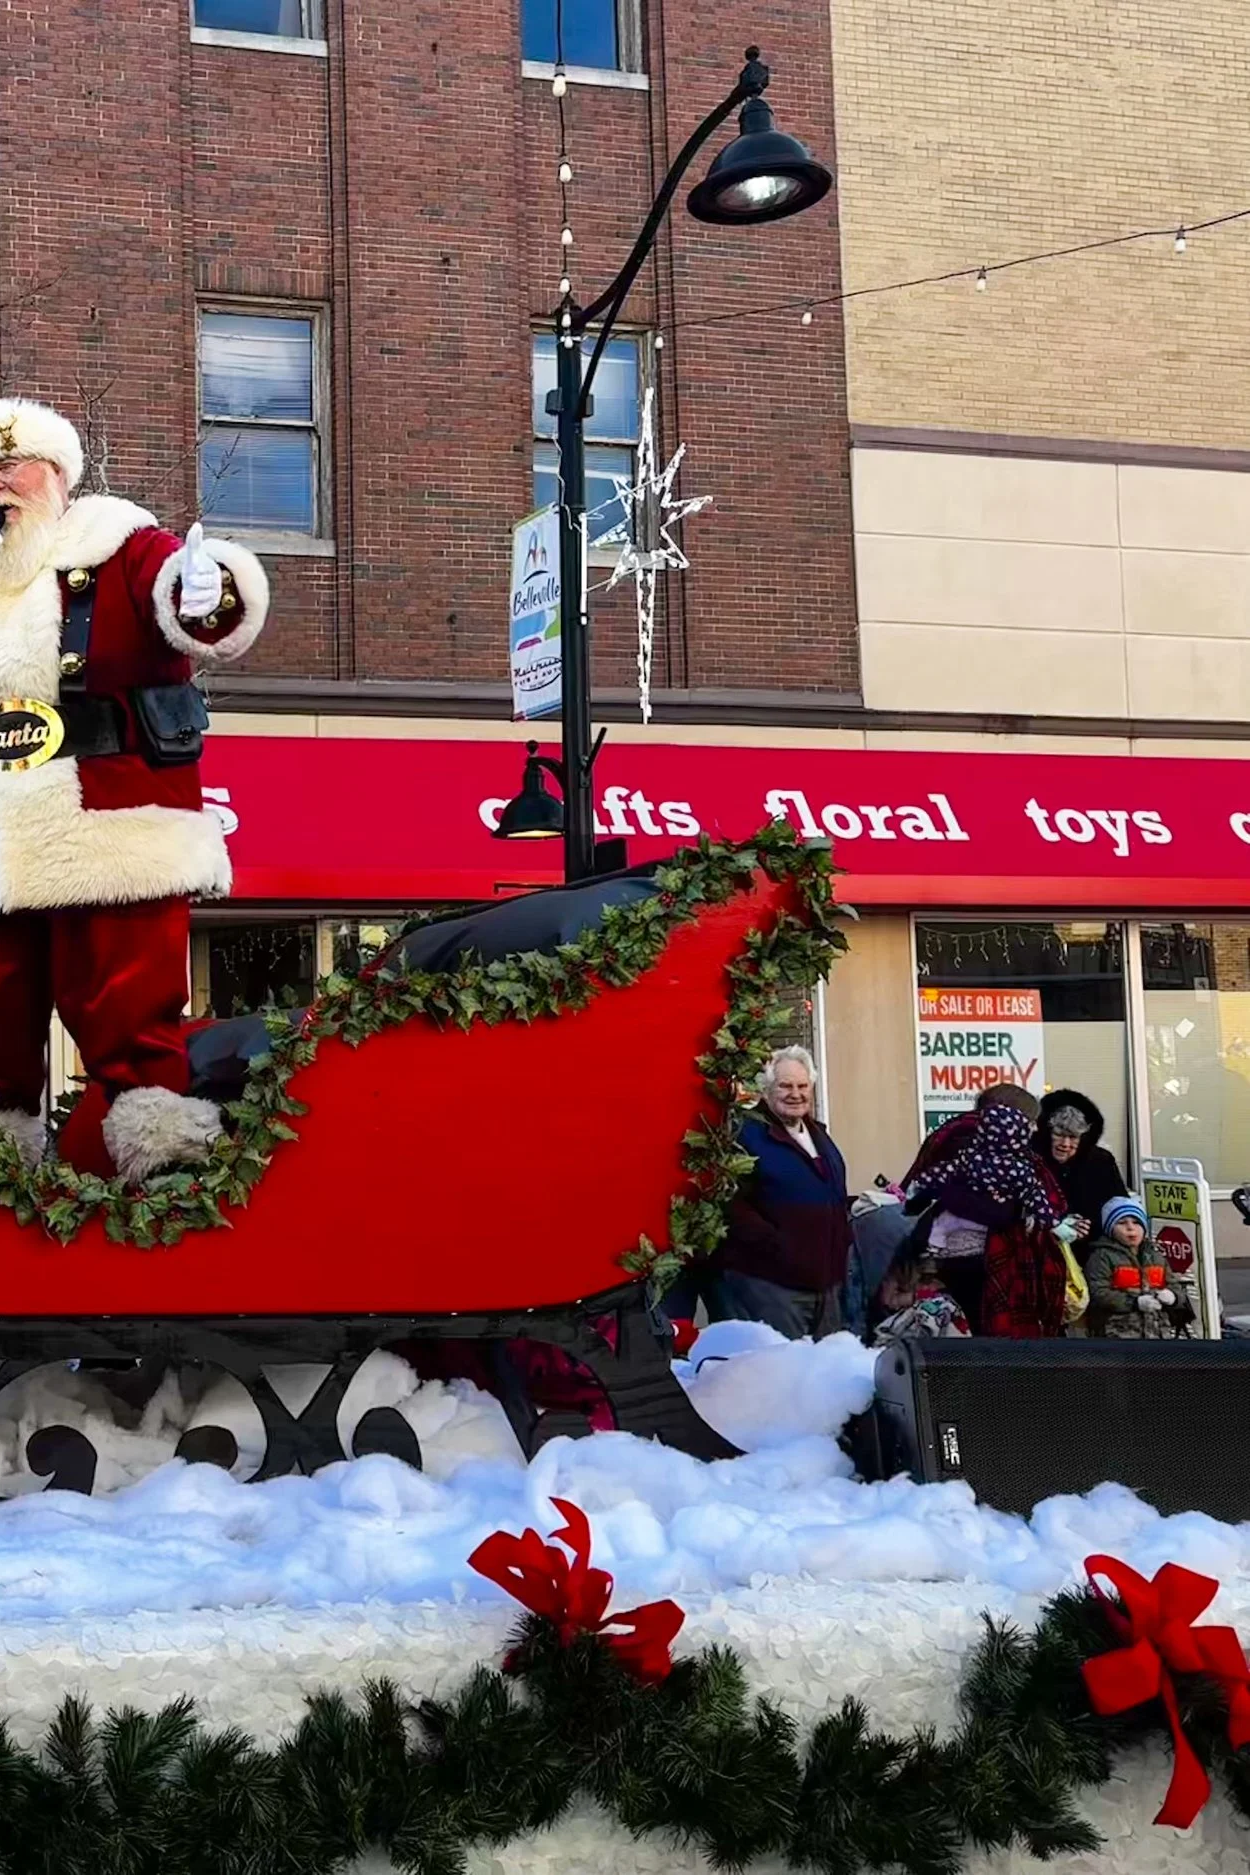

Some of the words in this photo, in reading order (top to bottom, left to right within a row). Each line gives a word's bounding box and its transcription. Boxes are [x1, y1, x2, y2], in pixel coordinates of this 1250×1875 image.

[513, 576, 560, 617] Belleville
[764, 789, 970, 841] floral
[1025, 798, 1173, 857] toys
[940, 995, 973, 1016] SALE
[976, 996, 994, 1016] OR
[996, 996, 1035, 1016] LEASE
[919, 1031, 1015, 1058] BARBER
[930, 1057, 1038, 1091] MURPHY
[1154, 1185, 1188, 1200] STATE
[1159, 1202, 1182, 1215] LAW
